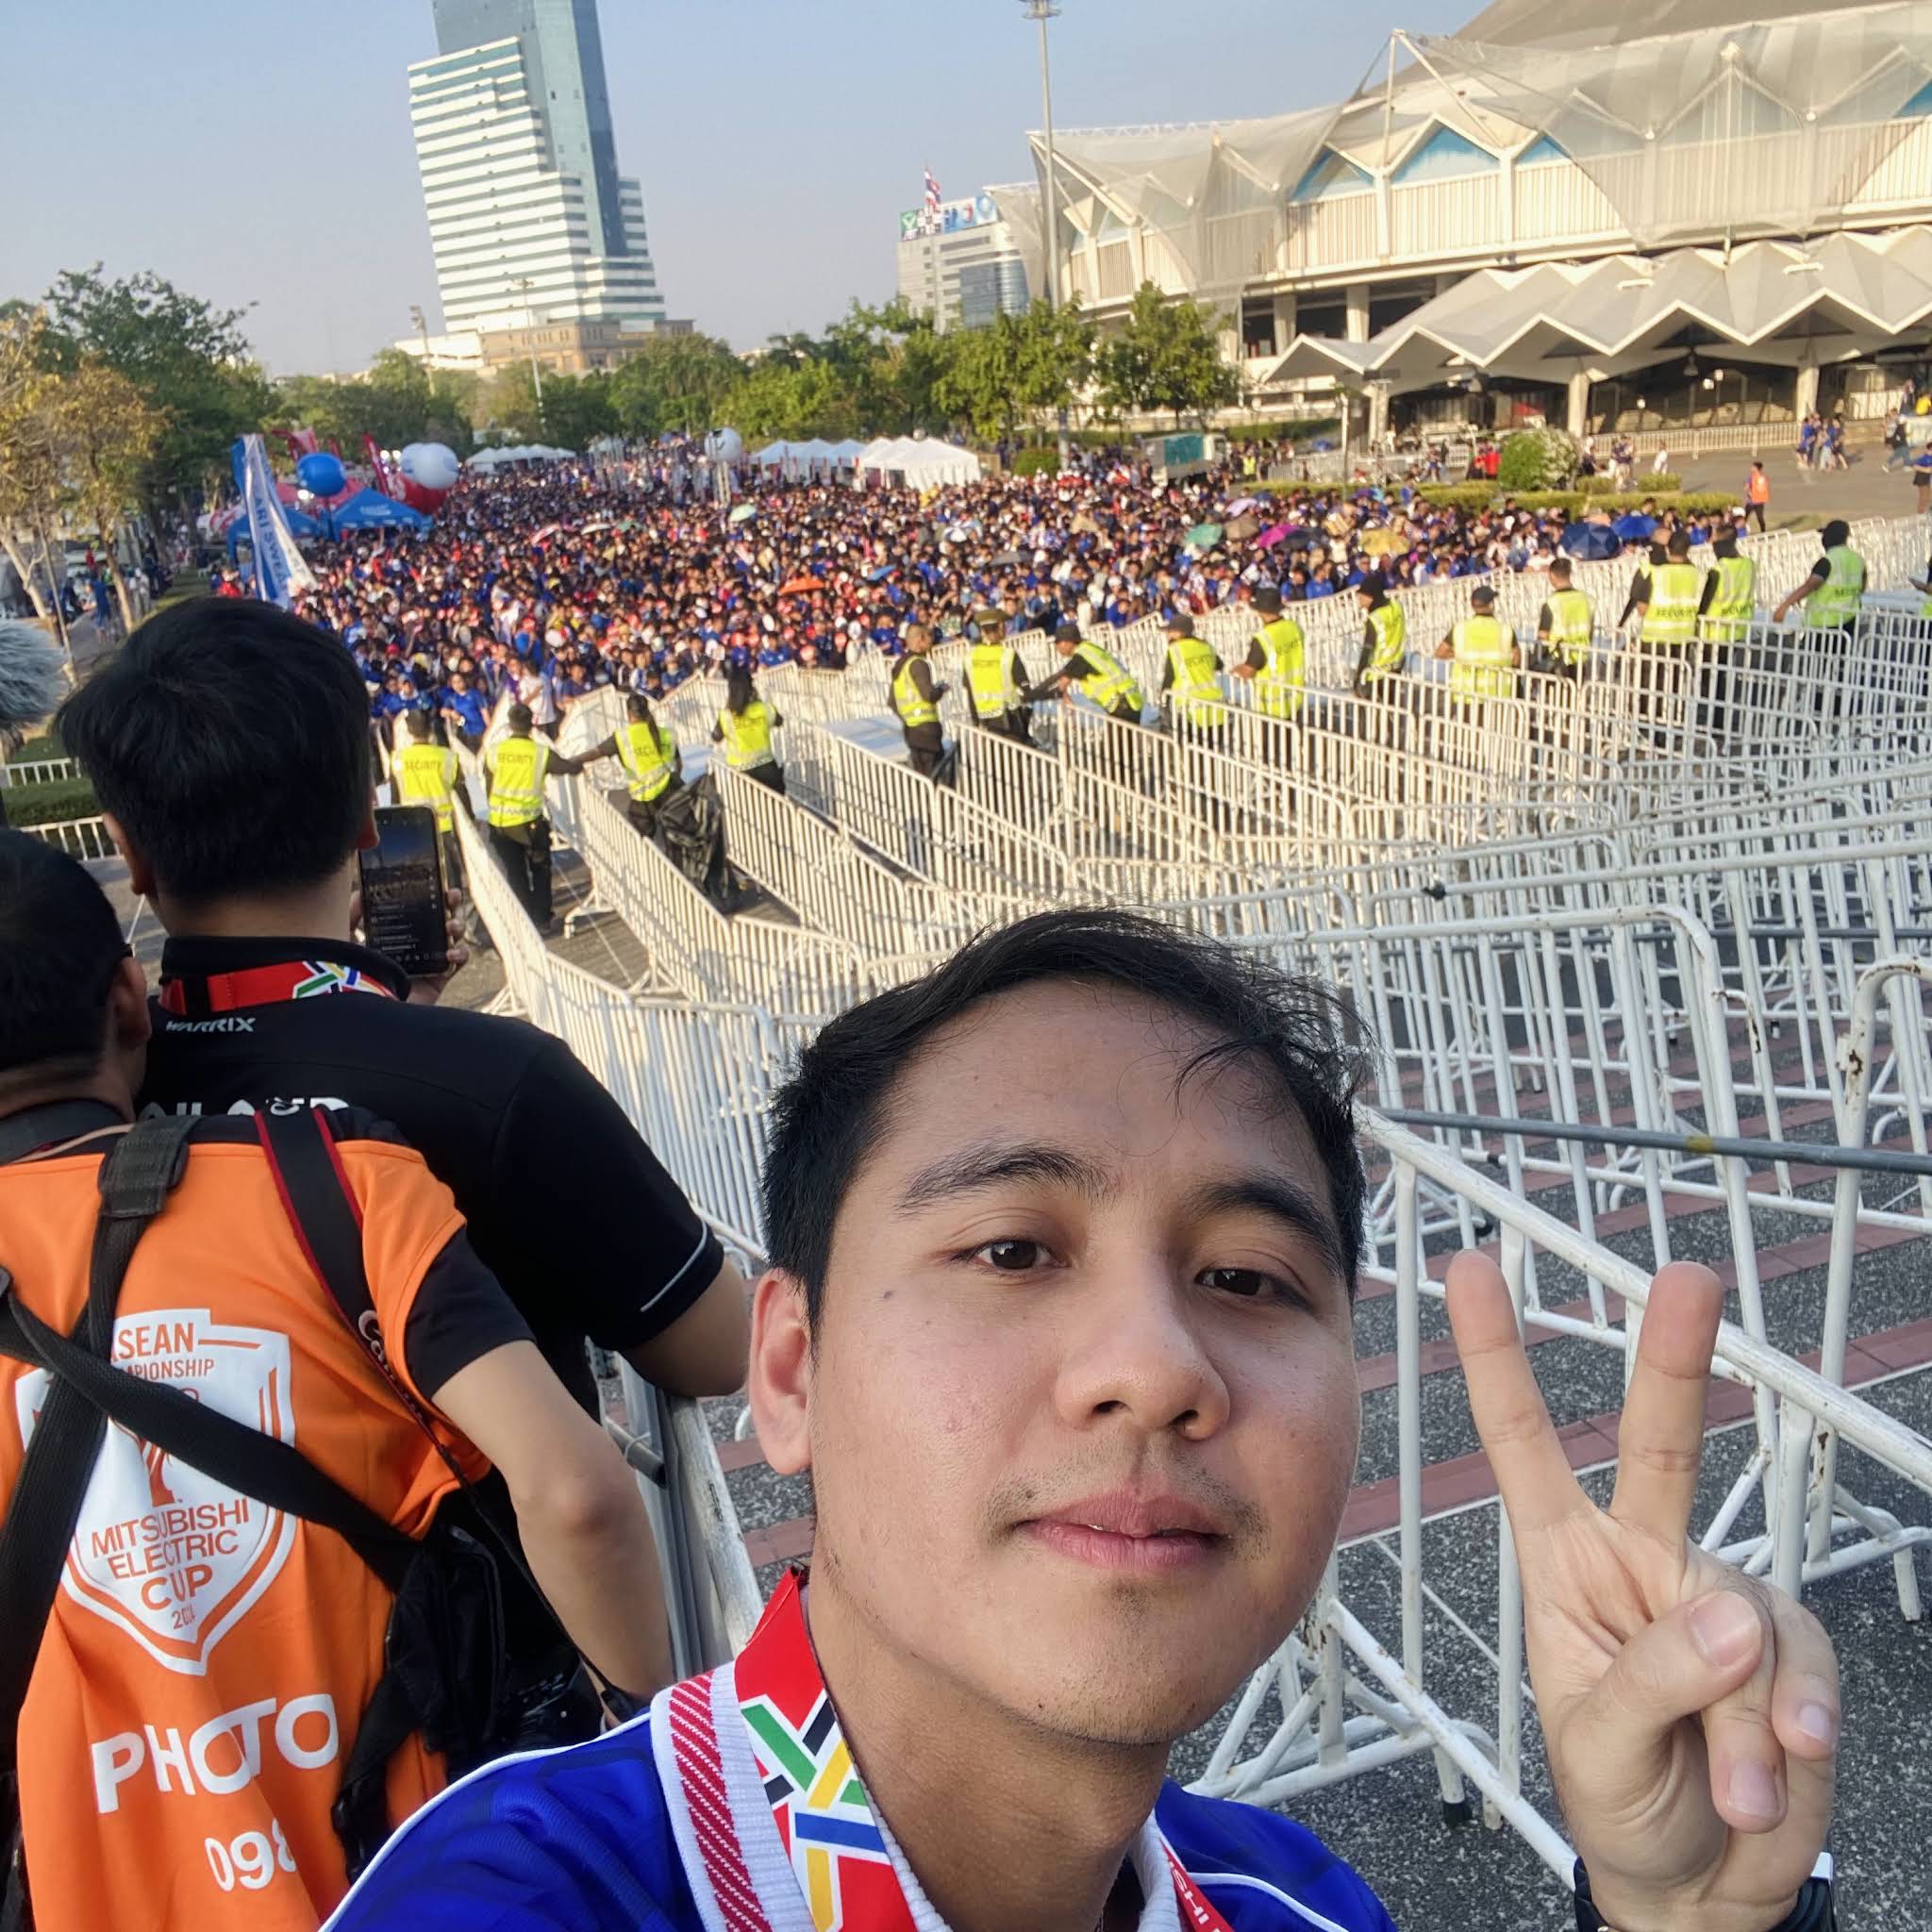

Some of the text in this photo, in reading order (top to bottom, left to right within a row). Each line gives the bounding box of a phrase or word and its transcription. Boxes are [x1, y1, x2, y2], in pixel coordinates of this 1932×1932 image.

[165, 1017, 257, 1033] WARRIX
[124, 1358, 215, 1381] PIONSHIP
[91, 1497, 250, 1558] MITSUBISHI
[108, 1529, 239, 1580] ELECTRIC
[141, 1564, 213, 1610] CUP
[91, 1693, 339, 1813] PHOTO
